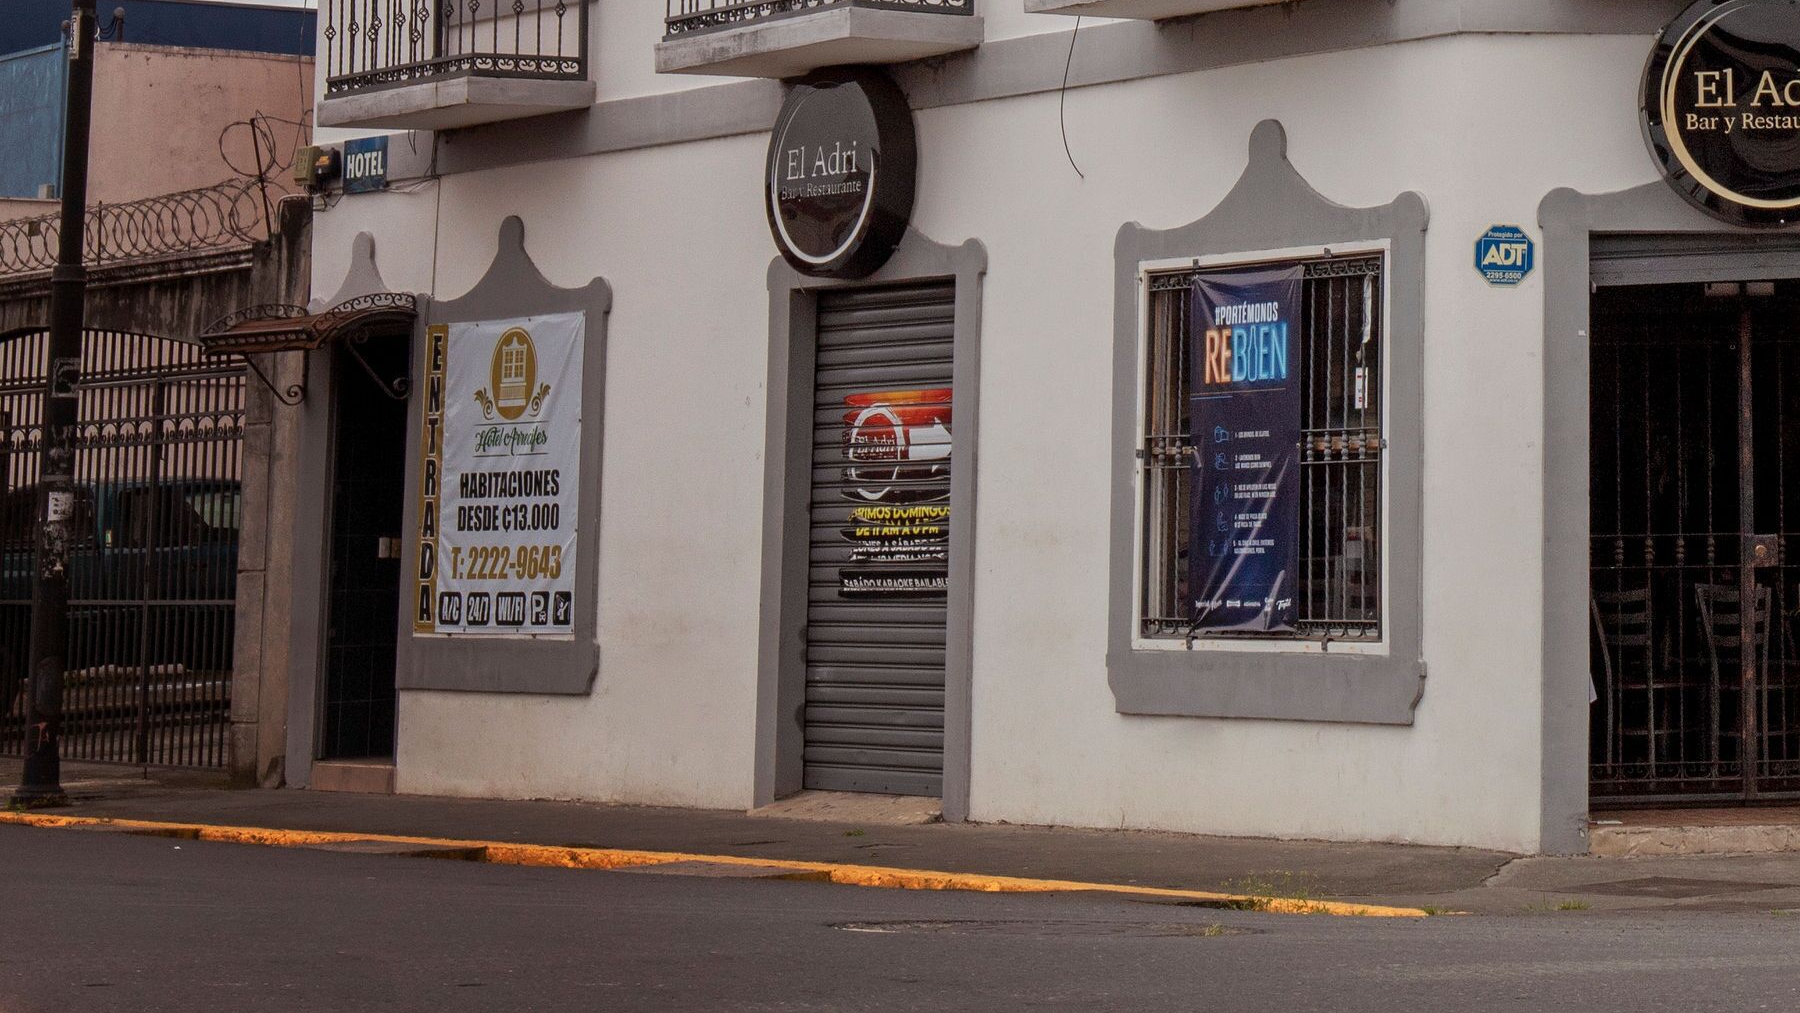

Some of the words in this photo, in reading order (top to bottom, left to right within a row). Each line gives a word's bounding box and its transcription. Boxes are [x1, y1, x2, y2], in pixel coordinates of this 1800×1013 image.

[1694, 68, 1736, 107] El
[1686, 113, 1720, 131] Bar
[1724, 117, 1736, 134] y
[346, 150, 384, 179] HOTEL
[786, 146, 806, 181] El
[811, 140, 857, 178] Adri
[806, 180, 862, 197] Restaurante
[1481, 243, 1527, 266] ADT
[1215, 301, 1279, 326] #PORTÉMONOS
[475, 427, 504, 452] Hotel
[419, 334, 443, 622] ENTRADA
[460, 469, 560, 499] HABITACIONES
[457, 505, 500, 532] DESDE
[451, 546, 465, 580] T:
[466, 544, 562, 580] 2222-9643
[876, 578, 913, 590] KARAOKE
[442, 596, 460, 621] A/C
[468, 595, 489, 621] 24/7
[498, 595, 524, 621] WI/FI
